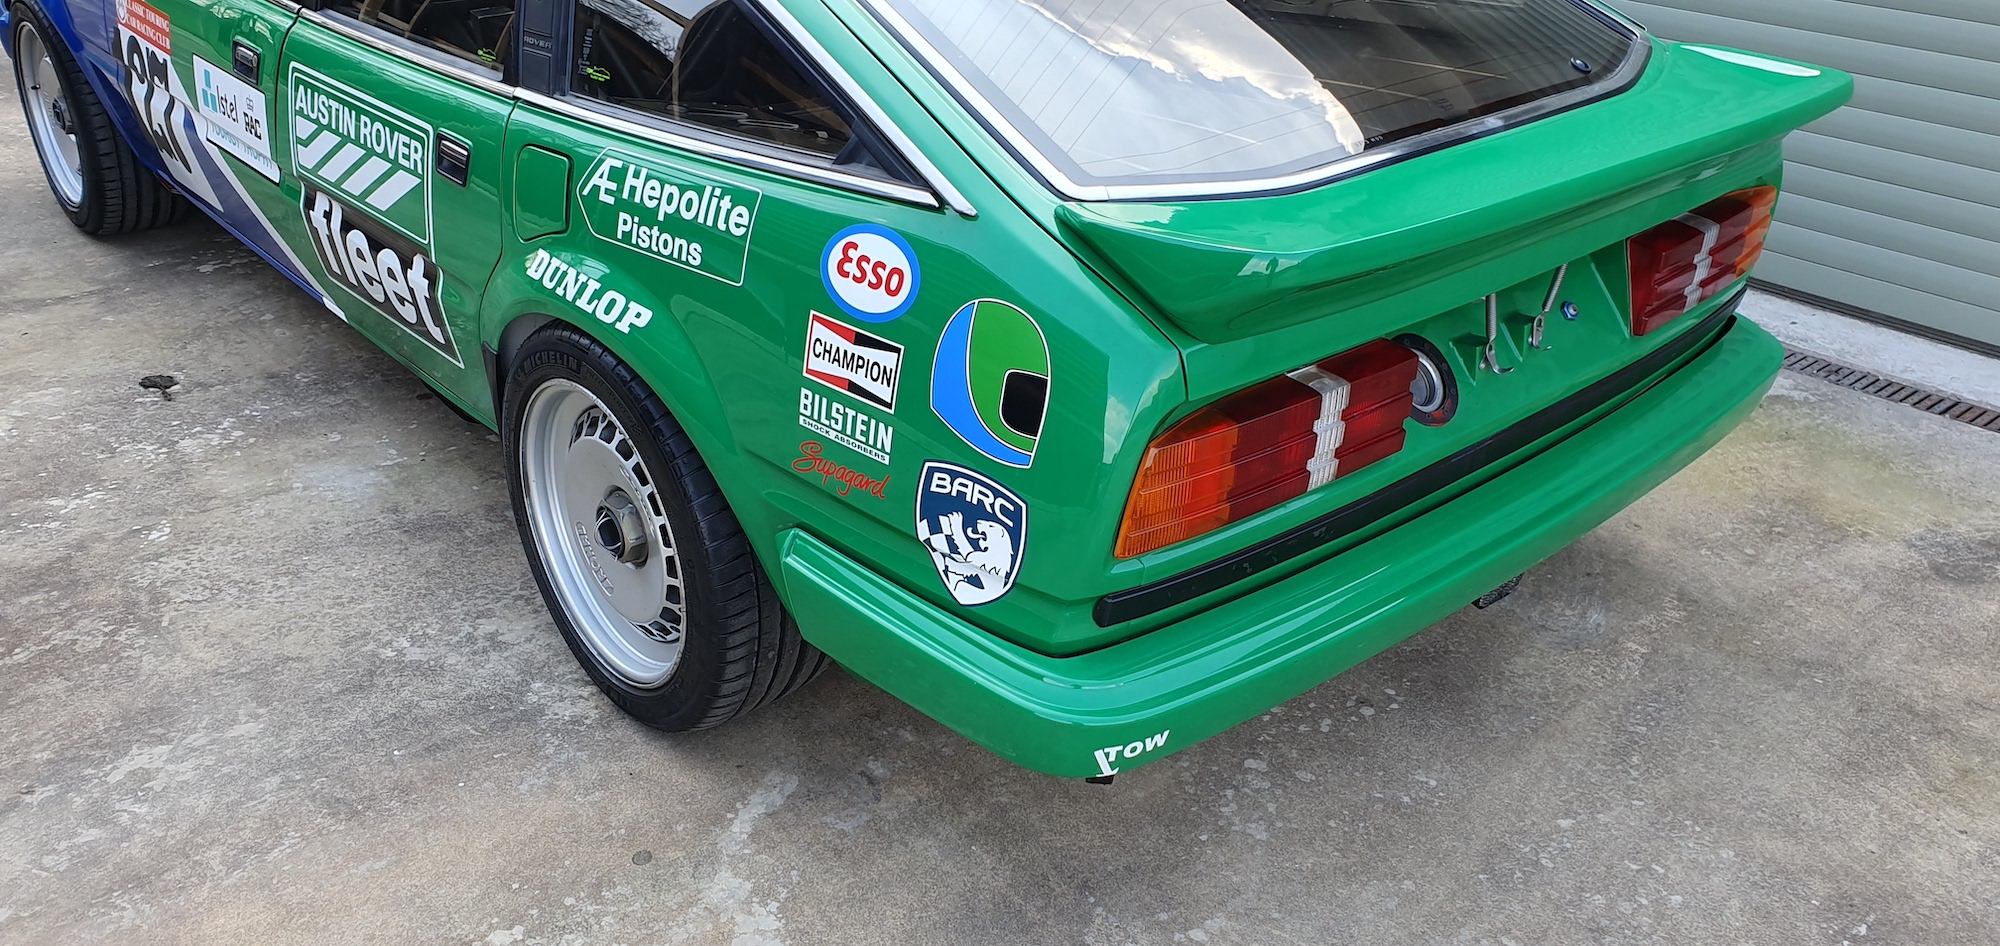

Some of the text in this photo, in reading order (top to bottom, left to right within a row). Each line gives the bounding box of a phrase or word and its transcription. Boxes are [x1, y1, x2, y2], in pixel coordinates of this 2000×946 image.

[126, 13, 171, 50] CAR RACING CLUB
[145, 9, 170, 33] TOURING
[523, 35, 553, 50] ROVER
[243, 111, 262, 141] RAC
[295, 84, 424, 175] AUSTIN ROVER
[621, 166, 750, 237] Hepolite
[616, 211, 703, 267] Pistons
[309, 190, 446, 345] fleet
[525, 248, 655, 335] DUNLOP
[523, 350, 580, 374] MICHELIN
[812, 337, 893, 388] CHAMPION
[799, 386, 894, 454] BILSTEIN
[802, 417, 887, 462] SHOCK ABSORBERS
[791, 440, 891, 500] Supagard
[929, 471, 1016, 528] BARC
[1103, 729, 1171, 763] TOW
